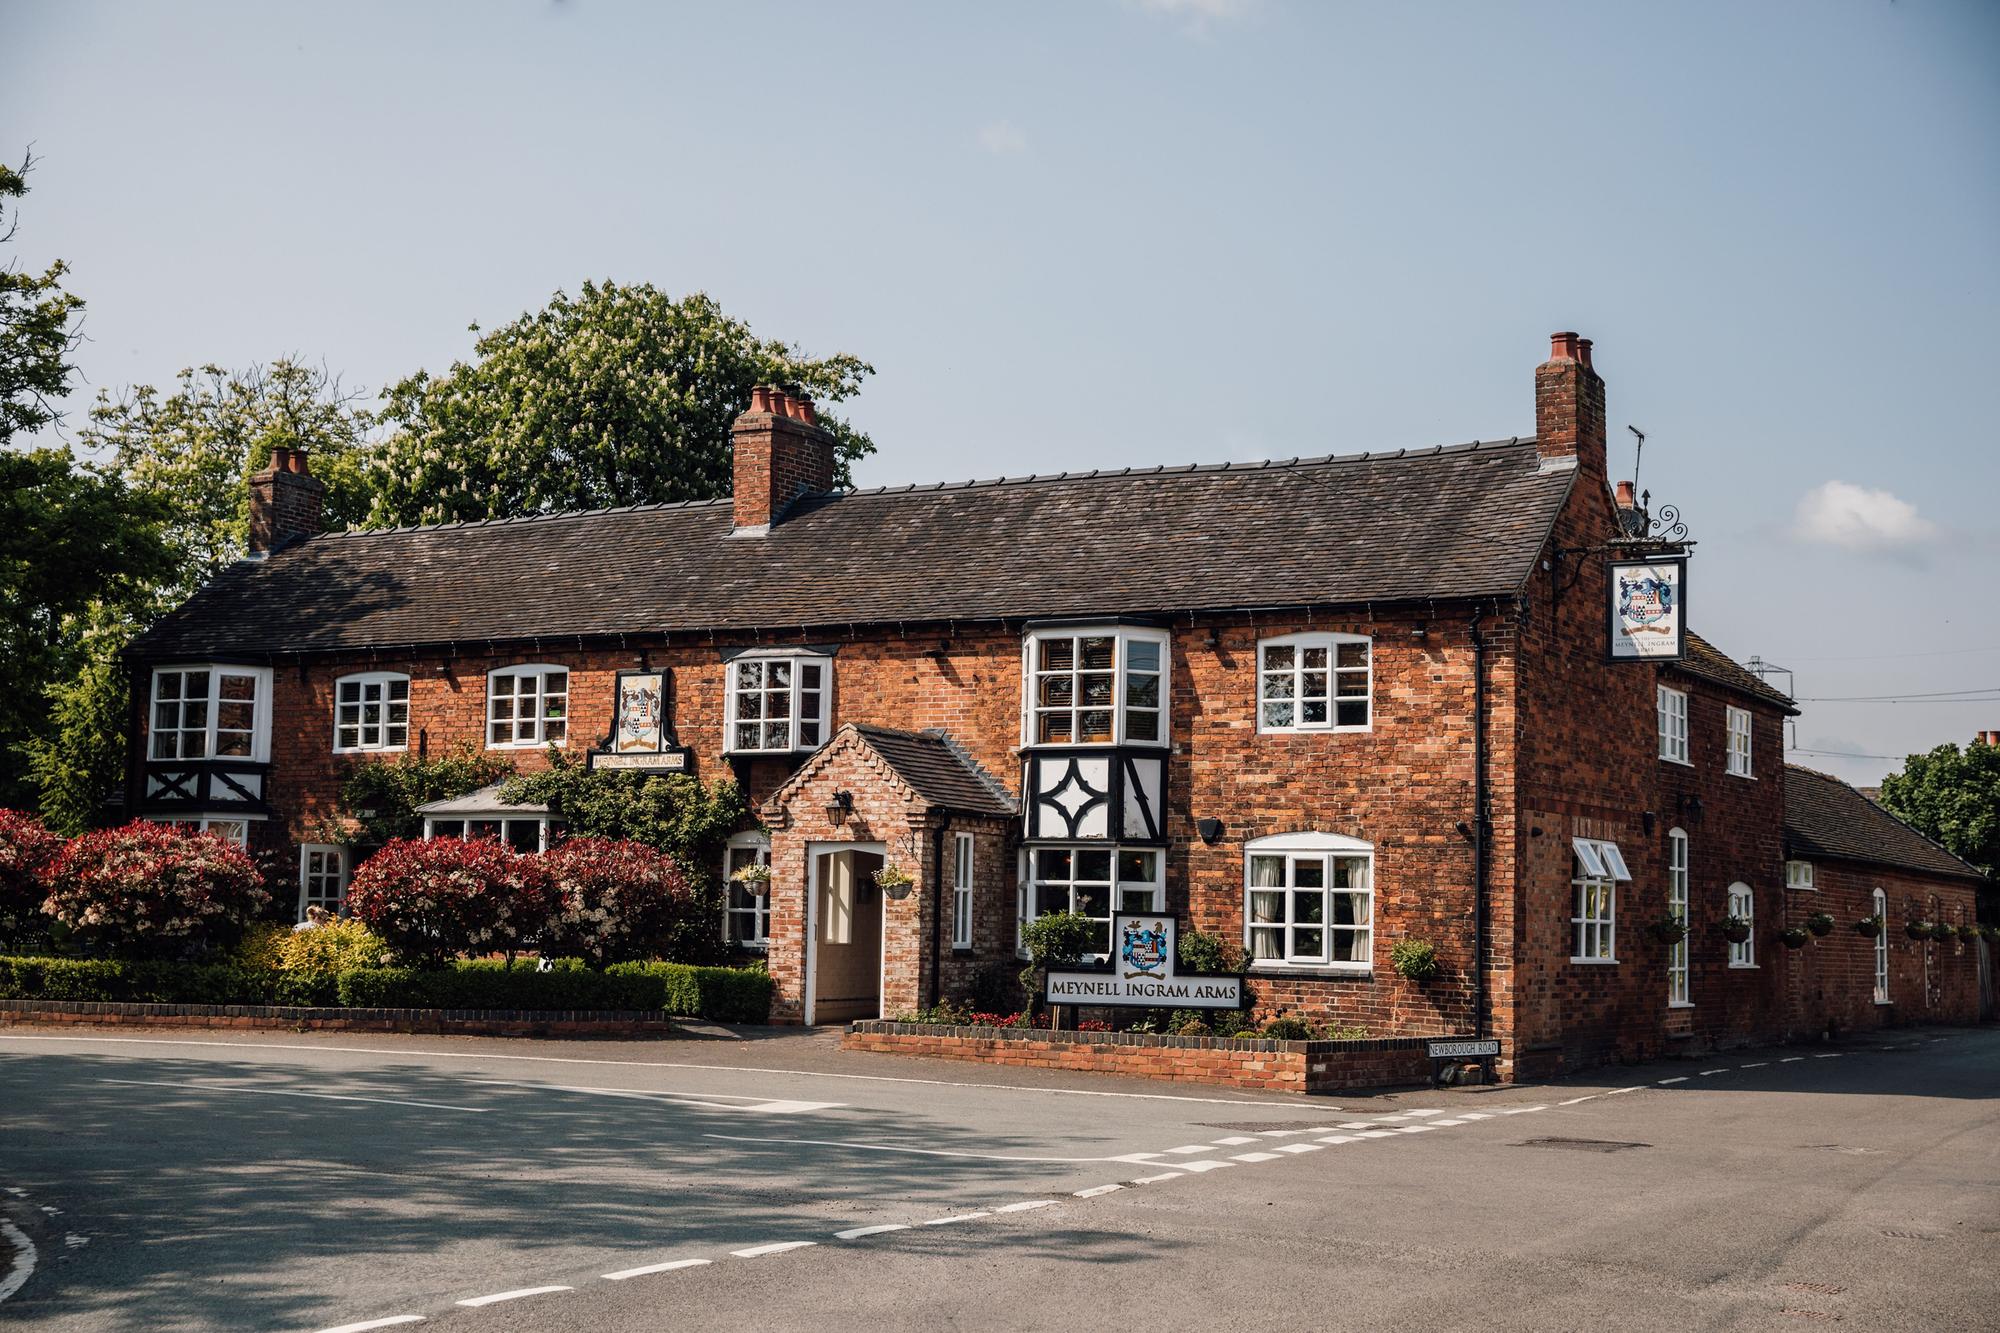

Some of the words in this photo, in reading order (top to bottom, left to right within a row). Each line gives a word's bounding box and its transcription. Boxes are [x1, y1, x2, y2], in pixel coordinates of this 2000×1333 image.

[660, 755, 683, 765] ARMS
[1051, 981, 1120, 996] MEYNELL
[1126, 983, 1189, 998] INGRAM
[1194, 985, 1236, 999] ARMS
[1430, 1044, 1475, 1056] NEWBOROUGH
[1478, 1042, 1497, 1053] ROAD
